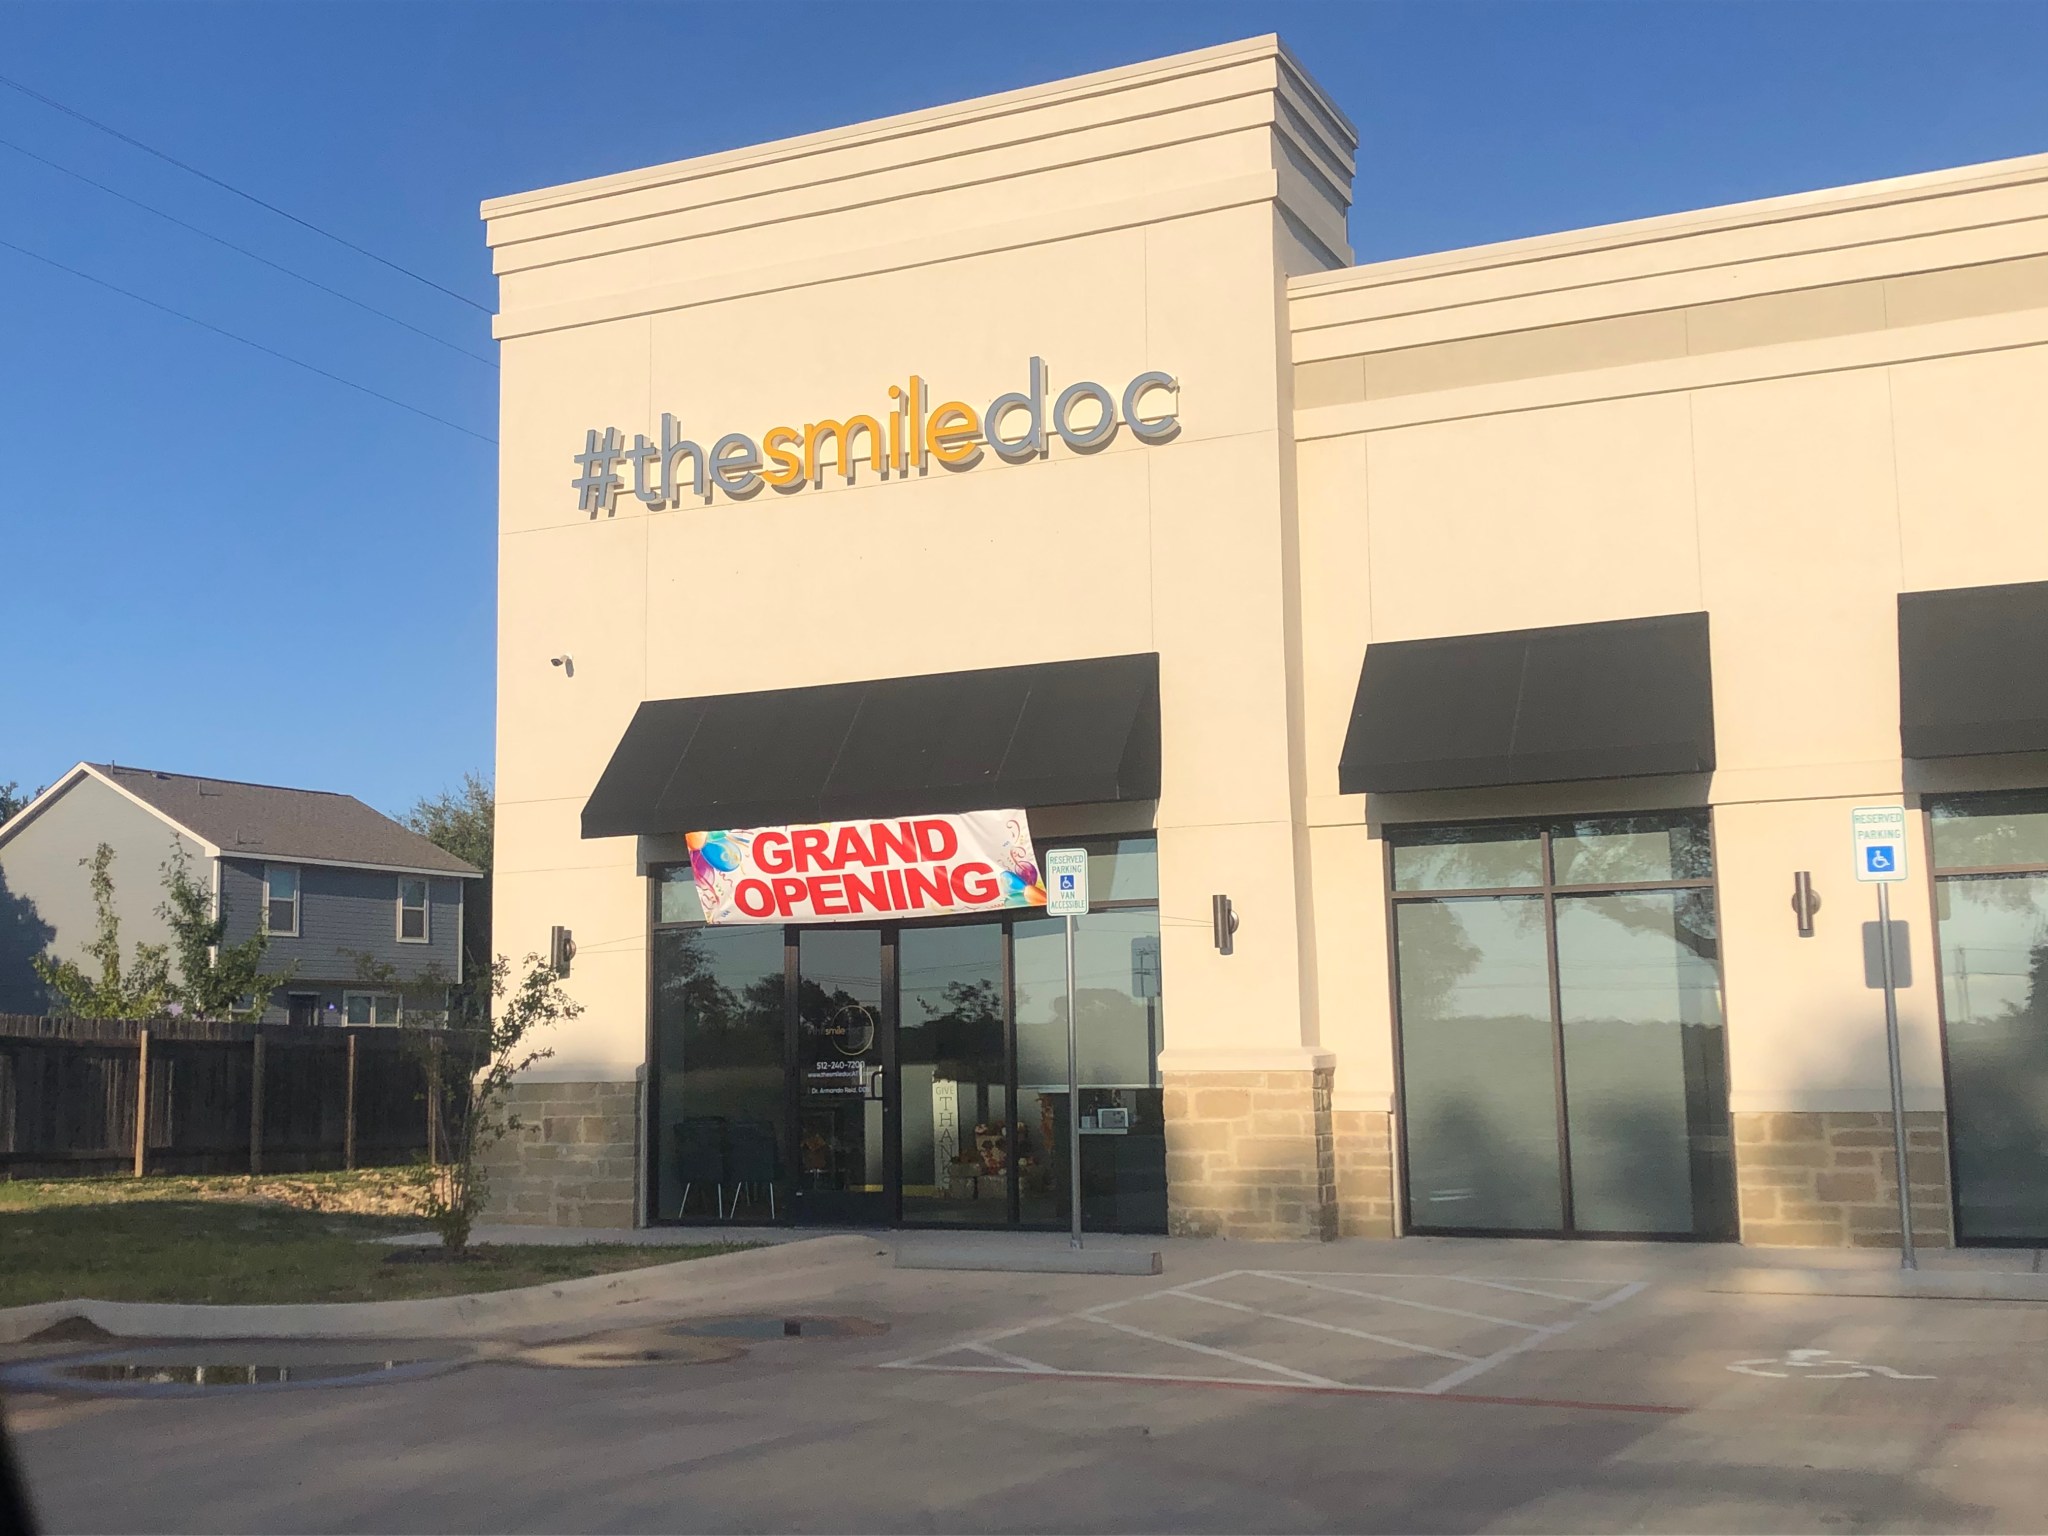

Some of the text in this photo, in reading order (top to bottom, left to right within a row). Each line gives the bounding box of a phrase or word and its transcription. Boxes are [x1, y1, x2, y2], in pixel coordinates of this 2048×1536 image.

[573, 356, 1178, 511] #thesmiledoc
[1854, 813, 1903, 824] RESERVED
[1858, 830, 1901, 839] PARKING
[752, 819, 958, 874] GRAND
[1050, 855, 1083, 864] RESERVED
[1052, 865, 1082, 873] PARKING
[734, 862, 1001, 918] OPENING
[1061, 891, 1075, 899] VAN
[1051, 900, 1085, 909] ACCESSIBLE
[816, 1060, 866, 1070] 512-240-7200
[935, 1087, 955, 1095] GIVE
